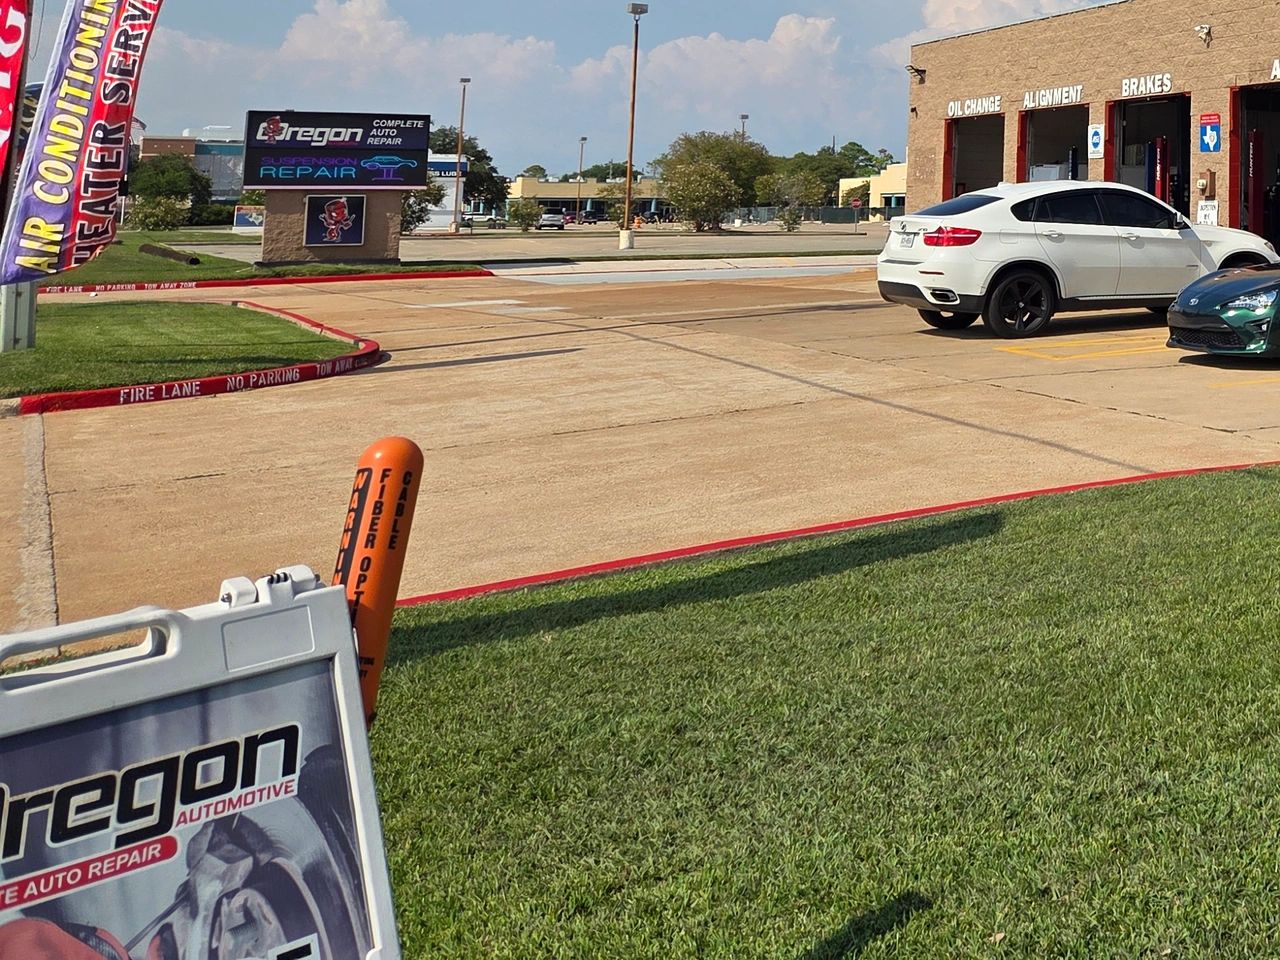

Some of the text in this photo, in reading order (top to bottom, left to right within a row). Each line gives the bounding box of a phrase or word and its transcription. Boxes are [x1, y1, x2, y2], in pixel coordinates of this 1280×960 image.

[1023, 85, 1083, 109] ALIGNMENT
[1121, 73, 1173, 97] BRAKES
[947, 96, 1001, 117] OIL CHANGE
[256, 122, 364, 146] Oregon
[370, 128, 397, 136] AUTO
[373, 119, 424, 128] COMPLETE
[366, 137, 402, 145] REPAIR
[259, 166, 356, 179] REPAIR
[260, 156, 358, 166] SUSPENSION
[72, 119, 128, 266] HEATER
[15, 216, 65, 275] AIR
[119, 385, 156, 404] FIRE
[162, 381, 201, 399] LANE
[227, 375, 244, 391] NO
[250, 368, 300, 386] PARKING
[316, 360, 333, 377] TOW
[363, 467, 393, 550] FIBER
[387, 470, 413, 550] CABLE
[331, 471, 369, 586] WARNIN
[0, 724, 300, 860] regon
[175, 778, 296, 828] AUTOMOTIVE
[23, 866, 82, 899] AUTO
[87, 843, 162, 877] REPAIR
